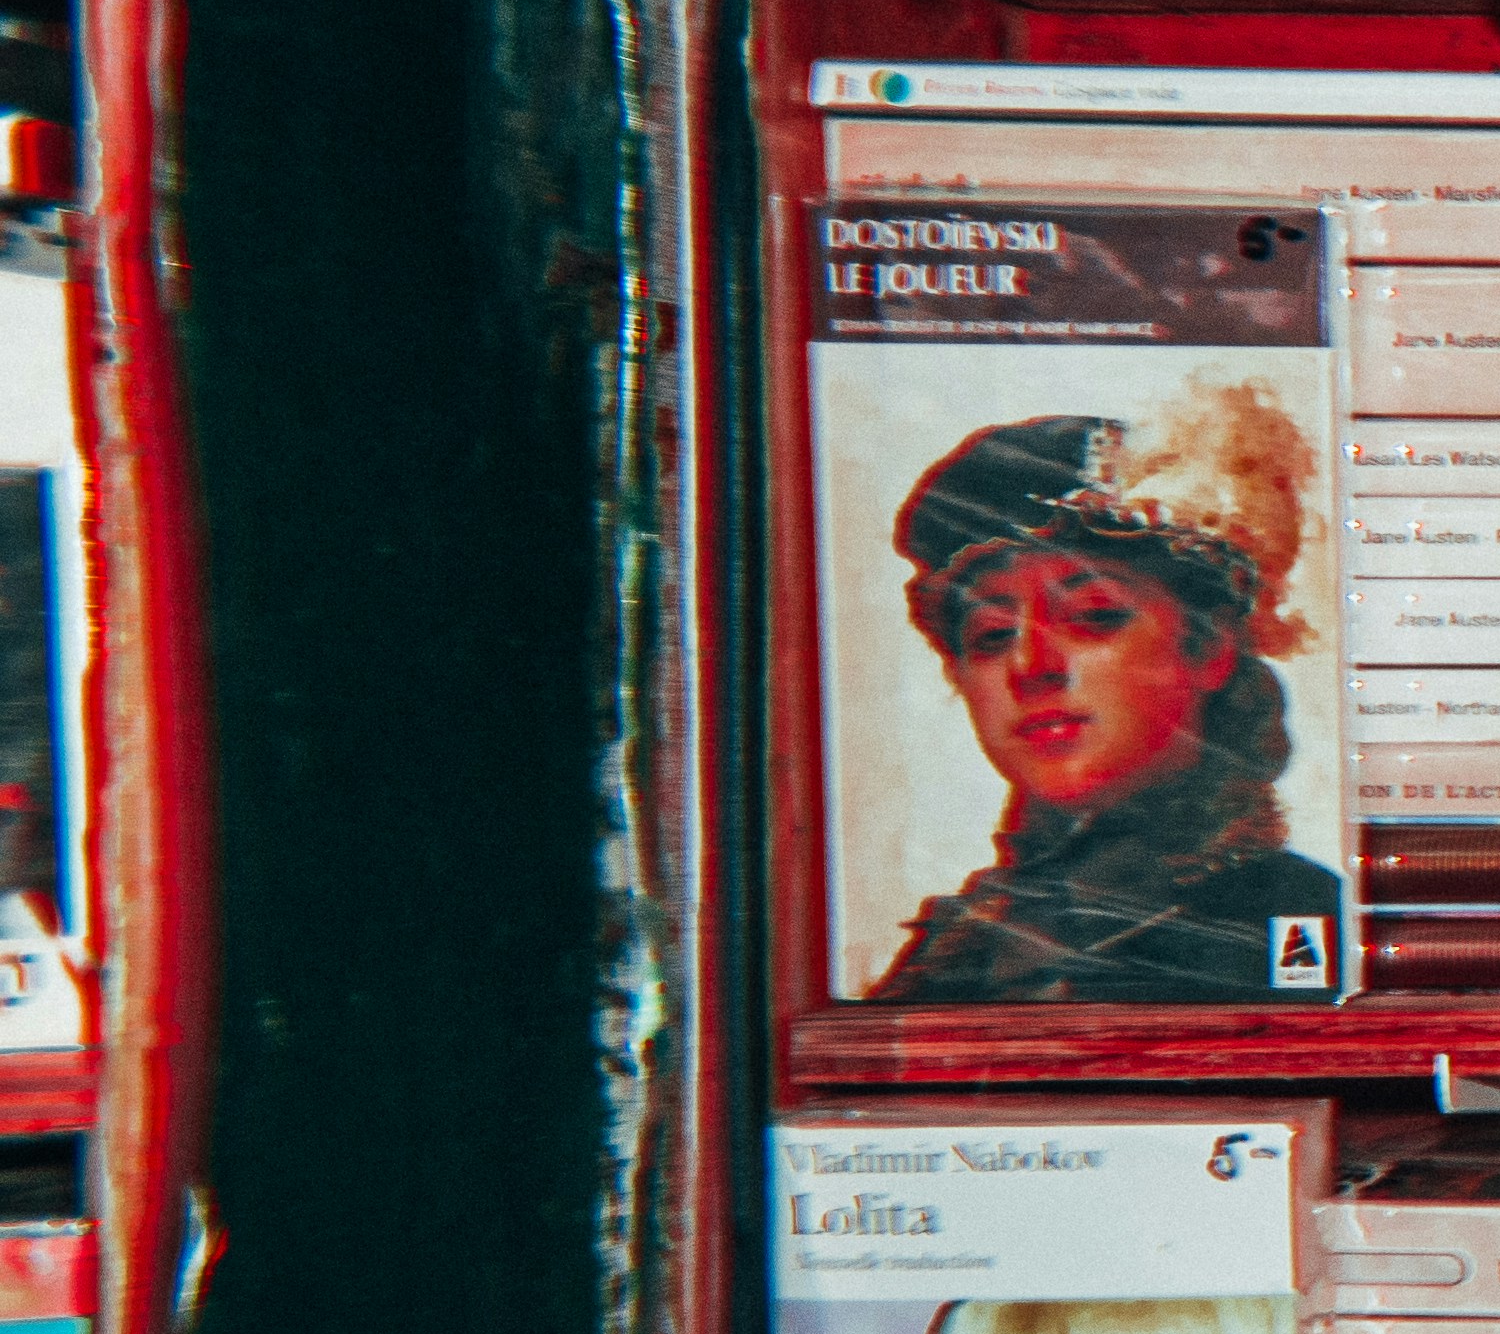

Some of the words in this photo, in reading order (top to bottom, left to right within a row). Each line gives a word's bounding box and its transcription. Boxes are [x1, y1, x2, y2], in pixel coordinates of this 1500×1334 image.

[825, 263, 875, 296] LE
[879, 262, 1029, 298] JOUEUR
[785, 1143, 945, 1175] Vladimir
[952, 1142, 1108, 1176] Nabokov
[789, 1192, 942, 1238] Lolita
